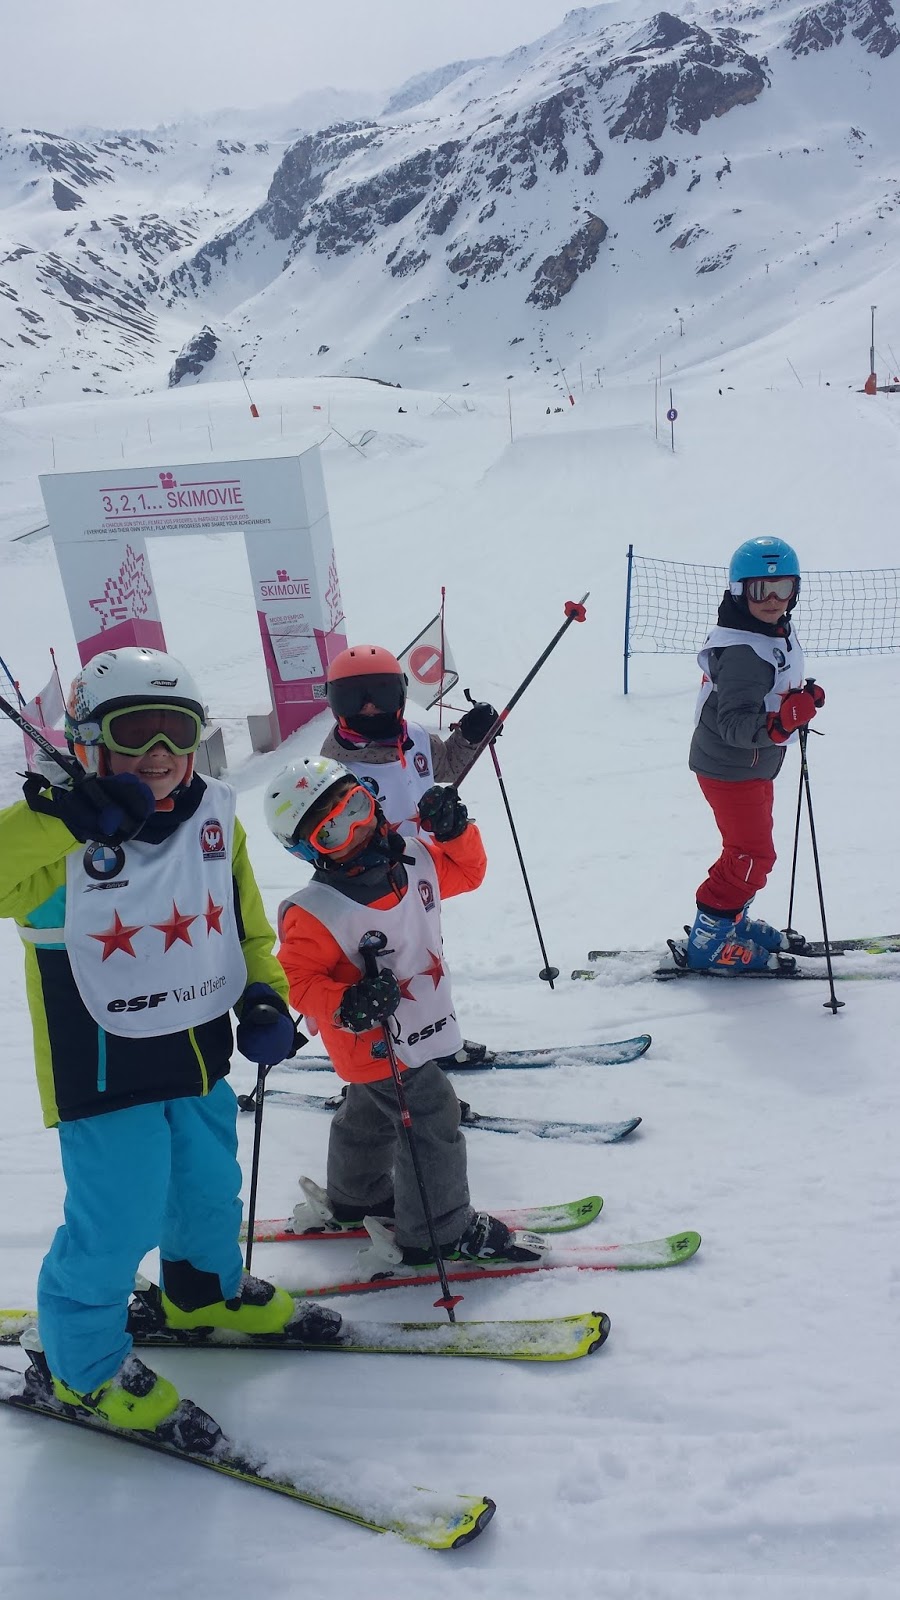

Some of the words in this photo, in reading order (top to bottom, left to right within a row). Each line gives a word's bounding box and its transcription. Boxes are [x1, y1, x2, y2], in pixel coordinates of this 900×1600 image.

[102, 493, 163, 514] 3,2,1...
[166, 487, 243, 508] SKIMOVIE
[238, 518, 271, 526] ACHIEVEMENTS
[260, 583, 311, 597] SKIMOVIE
[15, 716, 56, 753] GIPRON
[170, 984, 196, 1003] Val
[200, 974, 227, 997] d'Isère
